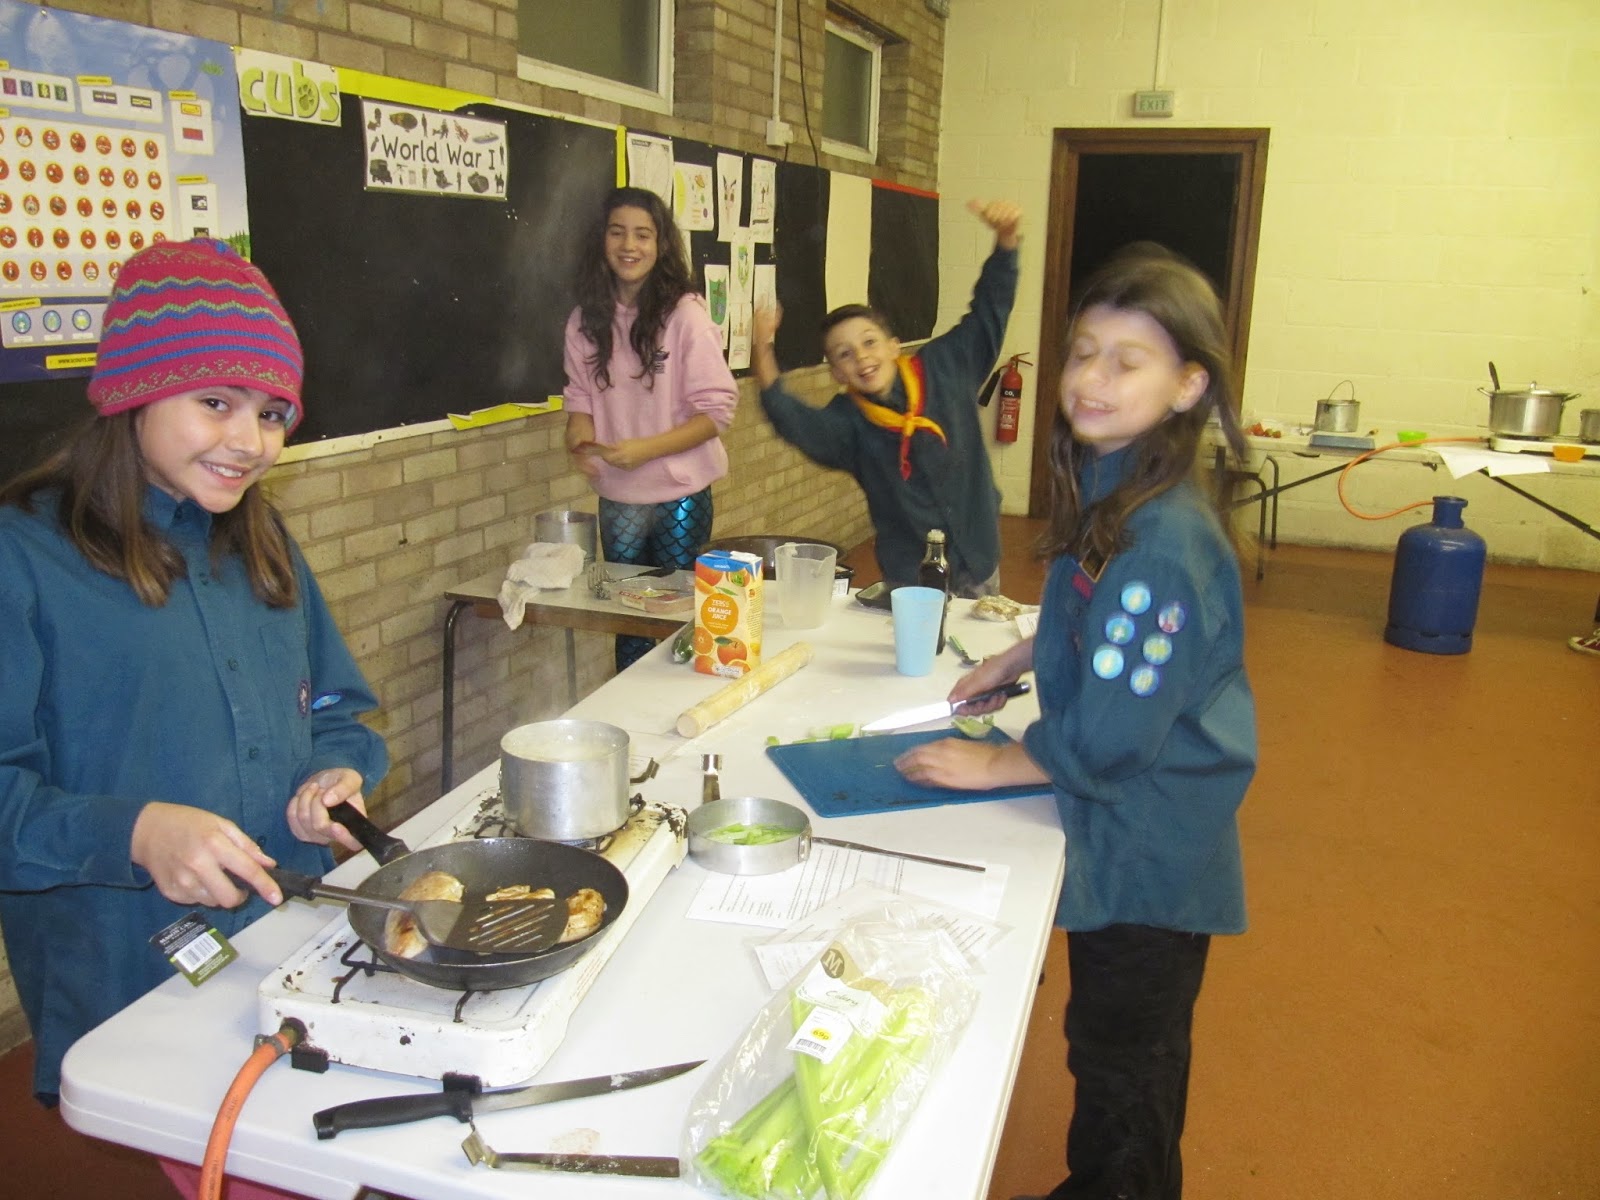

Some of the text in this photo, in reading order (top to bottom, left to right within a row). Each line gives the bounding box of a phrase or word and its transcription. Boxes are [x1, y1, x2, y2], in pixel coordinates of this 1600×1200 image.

[241, 61, 340, 122] cubs
[1140, 99, 1169, 111] EXIT
[382, 134, 496, 171] World War I
[707, 606, 732, 616] ORANGE
[711, 613, 727, 621] JUICE
[823, 950, 843, 977] M
[825, 990, 859, 1007] Celery
